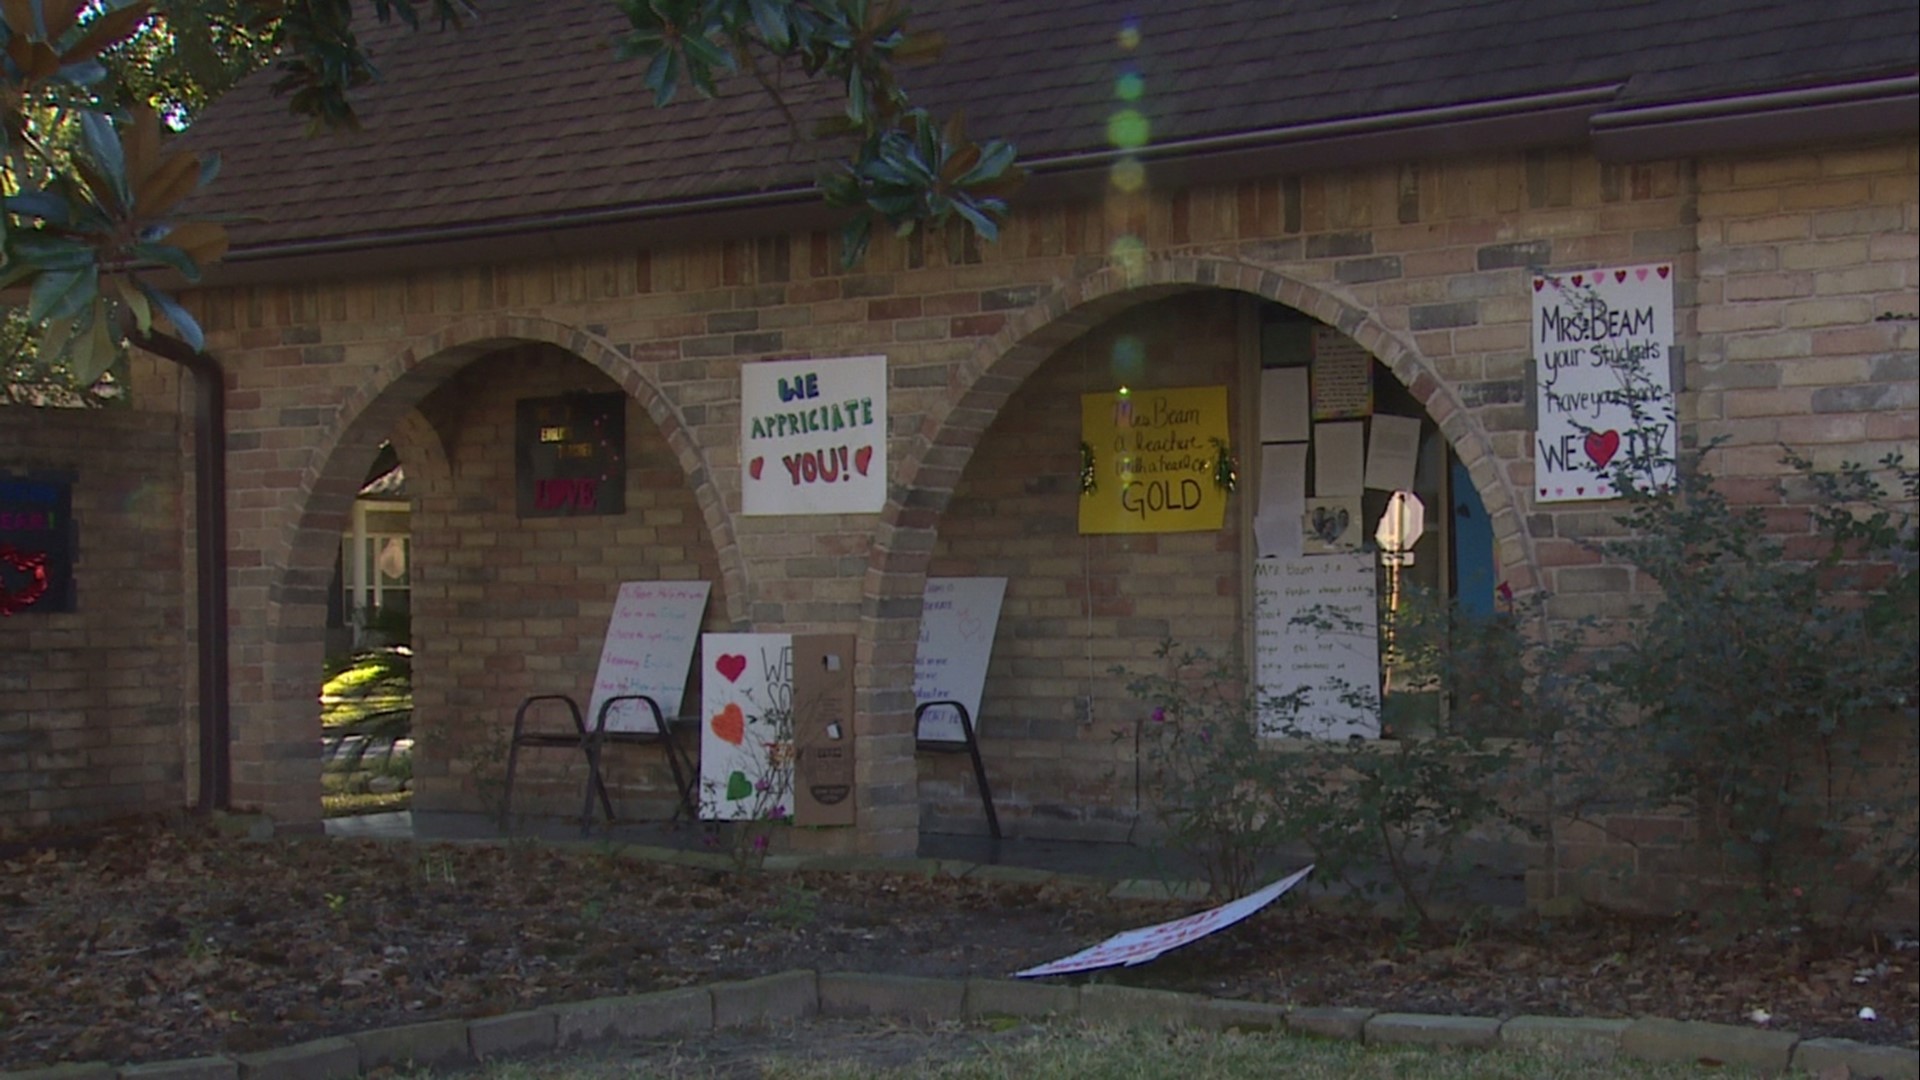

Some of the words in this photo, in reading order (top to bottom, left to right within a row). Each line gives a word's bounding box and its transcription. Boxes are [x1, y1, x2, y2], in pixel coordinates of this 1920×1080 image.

[1591, 298, 1655, 341] BEAM
[1544, 348, 1586, 386] your
[1590, 338, 1661, 367] Studnts
[777, 372, 820, 402] WE
[1546, 382, 1589, 413] have
[1591, 389, 1620, 419] you
[751, 397, 874, 440] APPRICIATE
[1153, 396, 1201, 428] Beam
[782, 445, 850, 486] YOU!
[1538, 435, 1578, 473] WE
[534, 479, 597, 511] LOVE
[1121, 478, 1202, 521] GOLD
[760, 646, 793, 683] WE
